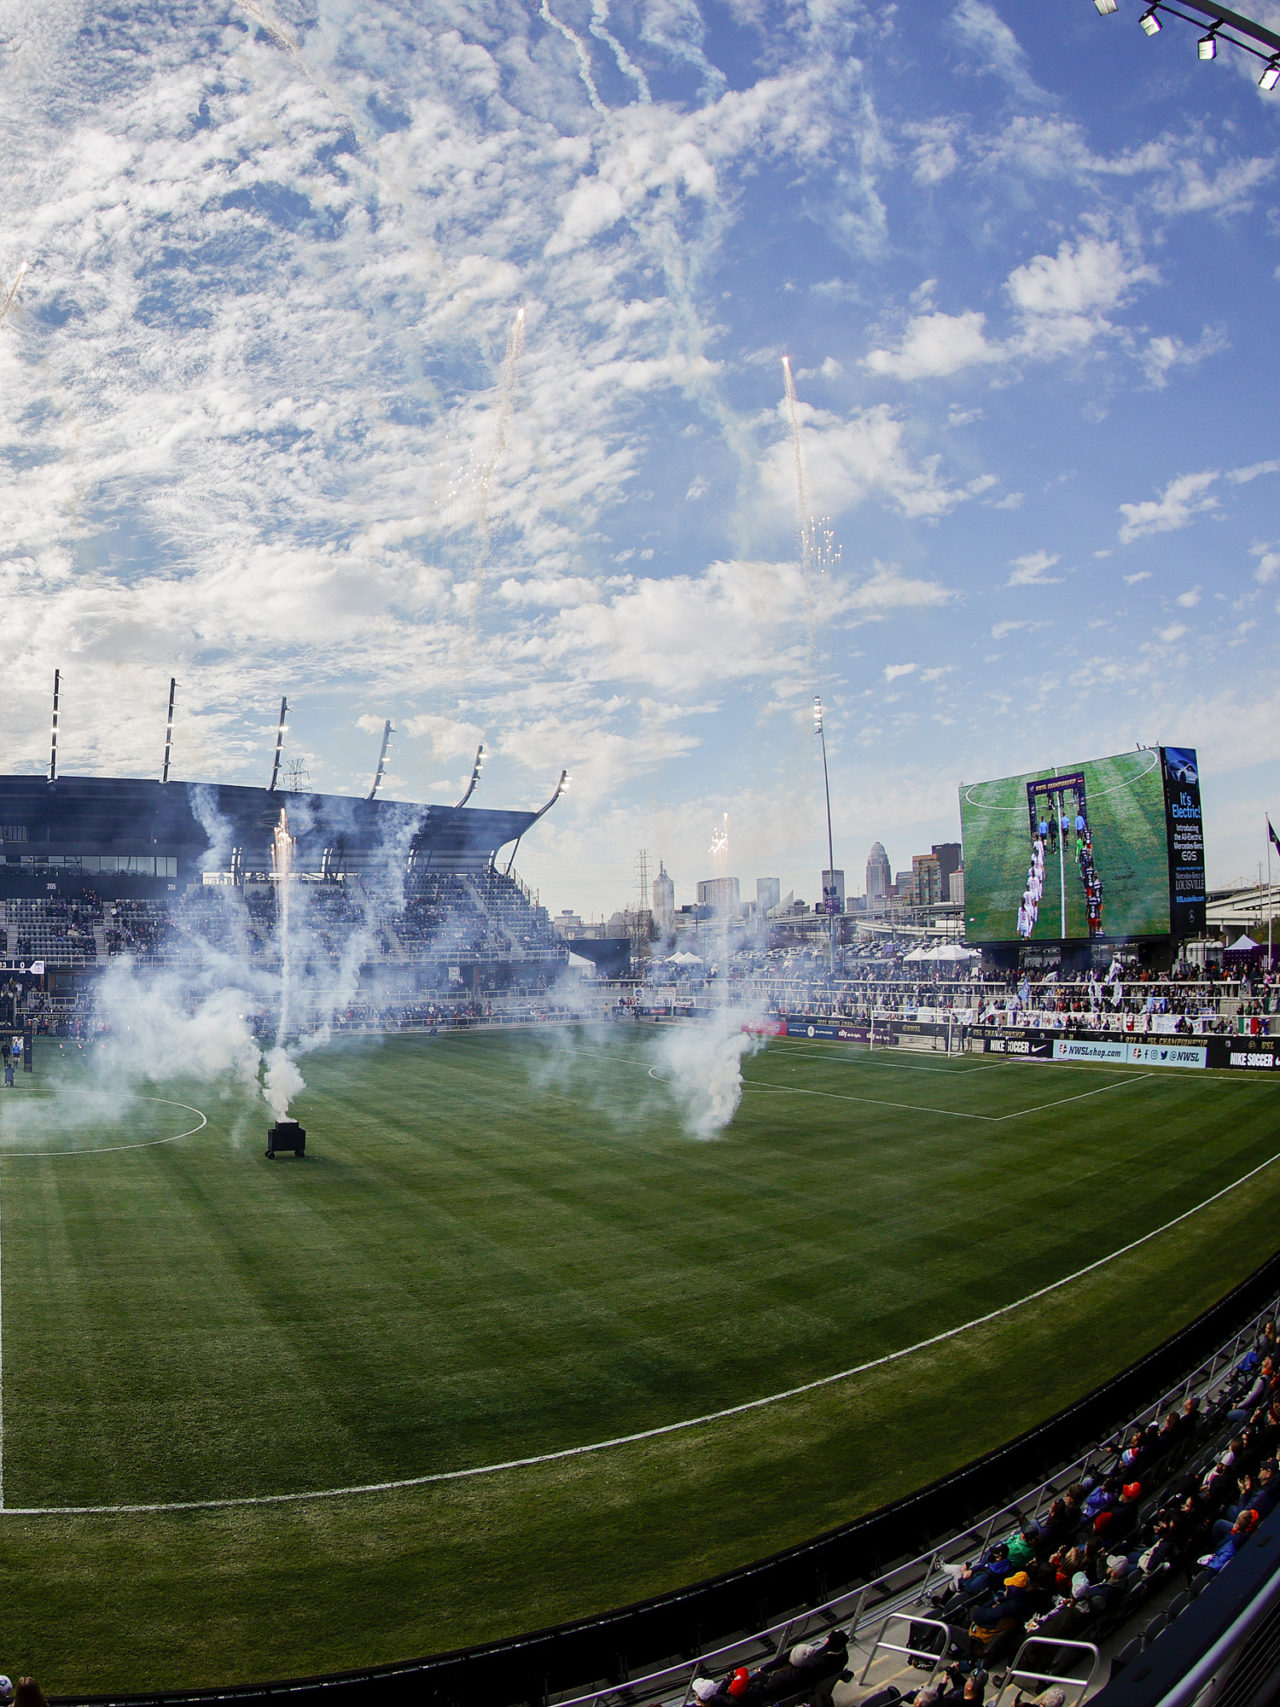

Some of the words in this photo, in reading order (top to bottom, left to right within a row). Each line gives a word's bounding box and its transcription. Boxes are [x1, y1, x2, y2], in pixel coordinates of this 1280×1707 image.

[1180, 792, 1192, 805] It's
[1172, 804, 1201, 818] Electric!
[1182, 851, 1197, 861] EQS
[990, 1040, 1005, 1052] NIKE
[1007, 1041, 1029, 1053] SOCCER
[1069, 1046, 1120, 1058] NWSLshop.com
[1170, 1051, 1199, 1062] @NWSL
[1230, 1052, 1247, 1065] NIKE
[1247, 1053, 1273, 1067] SOCCER
